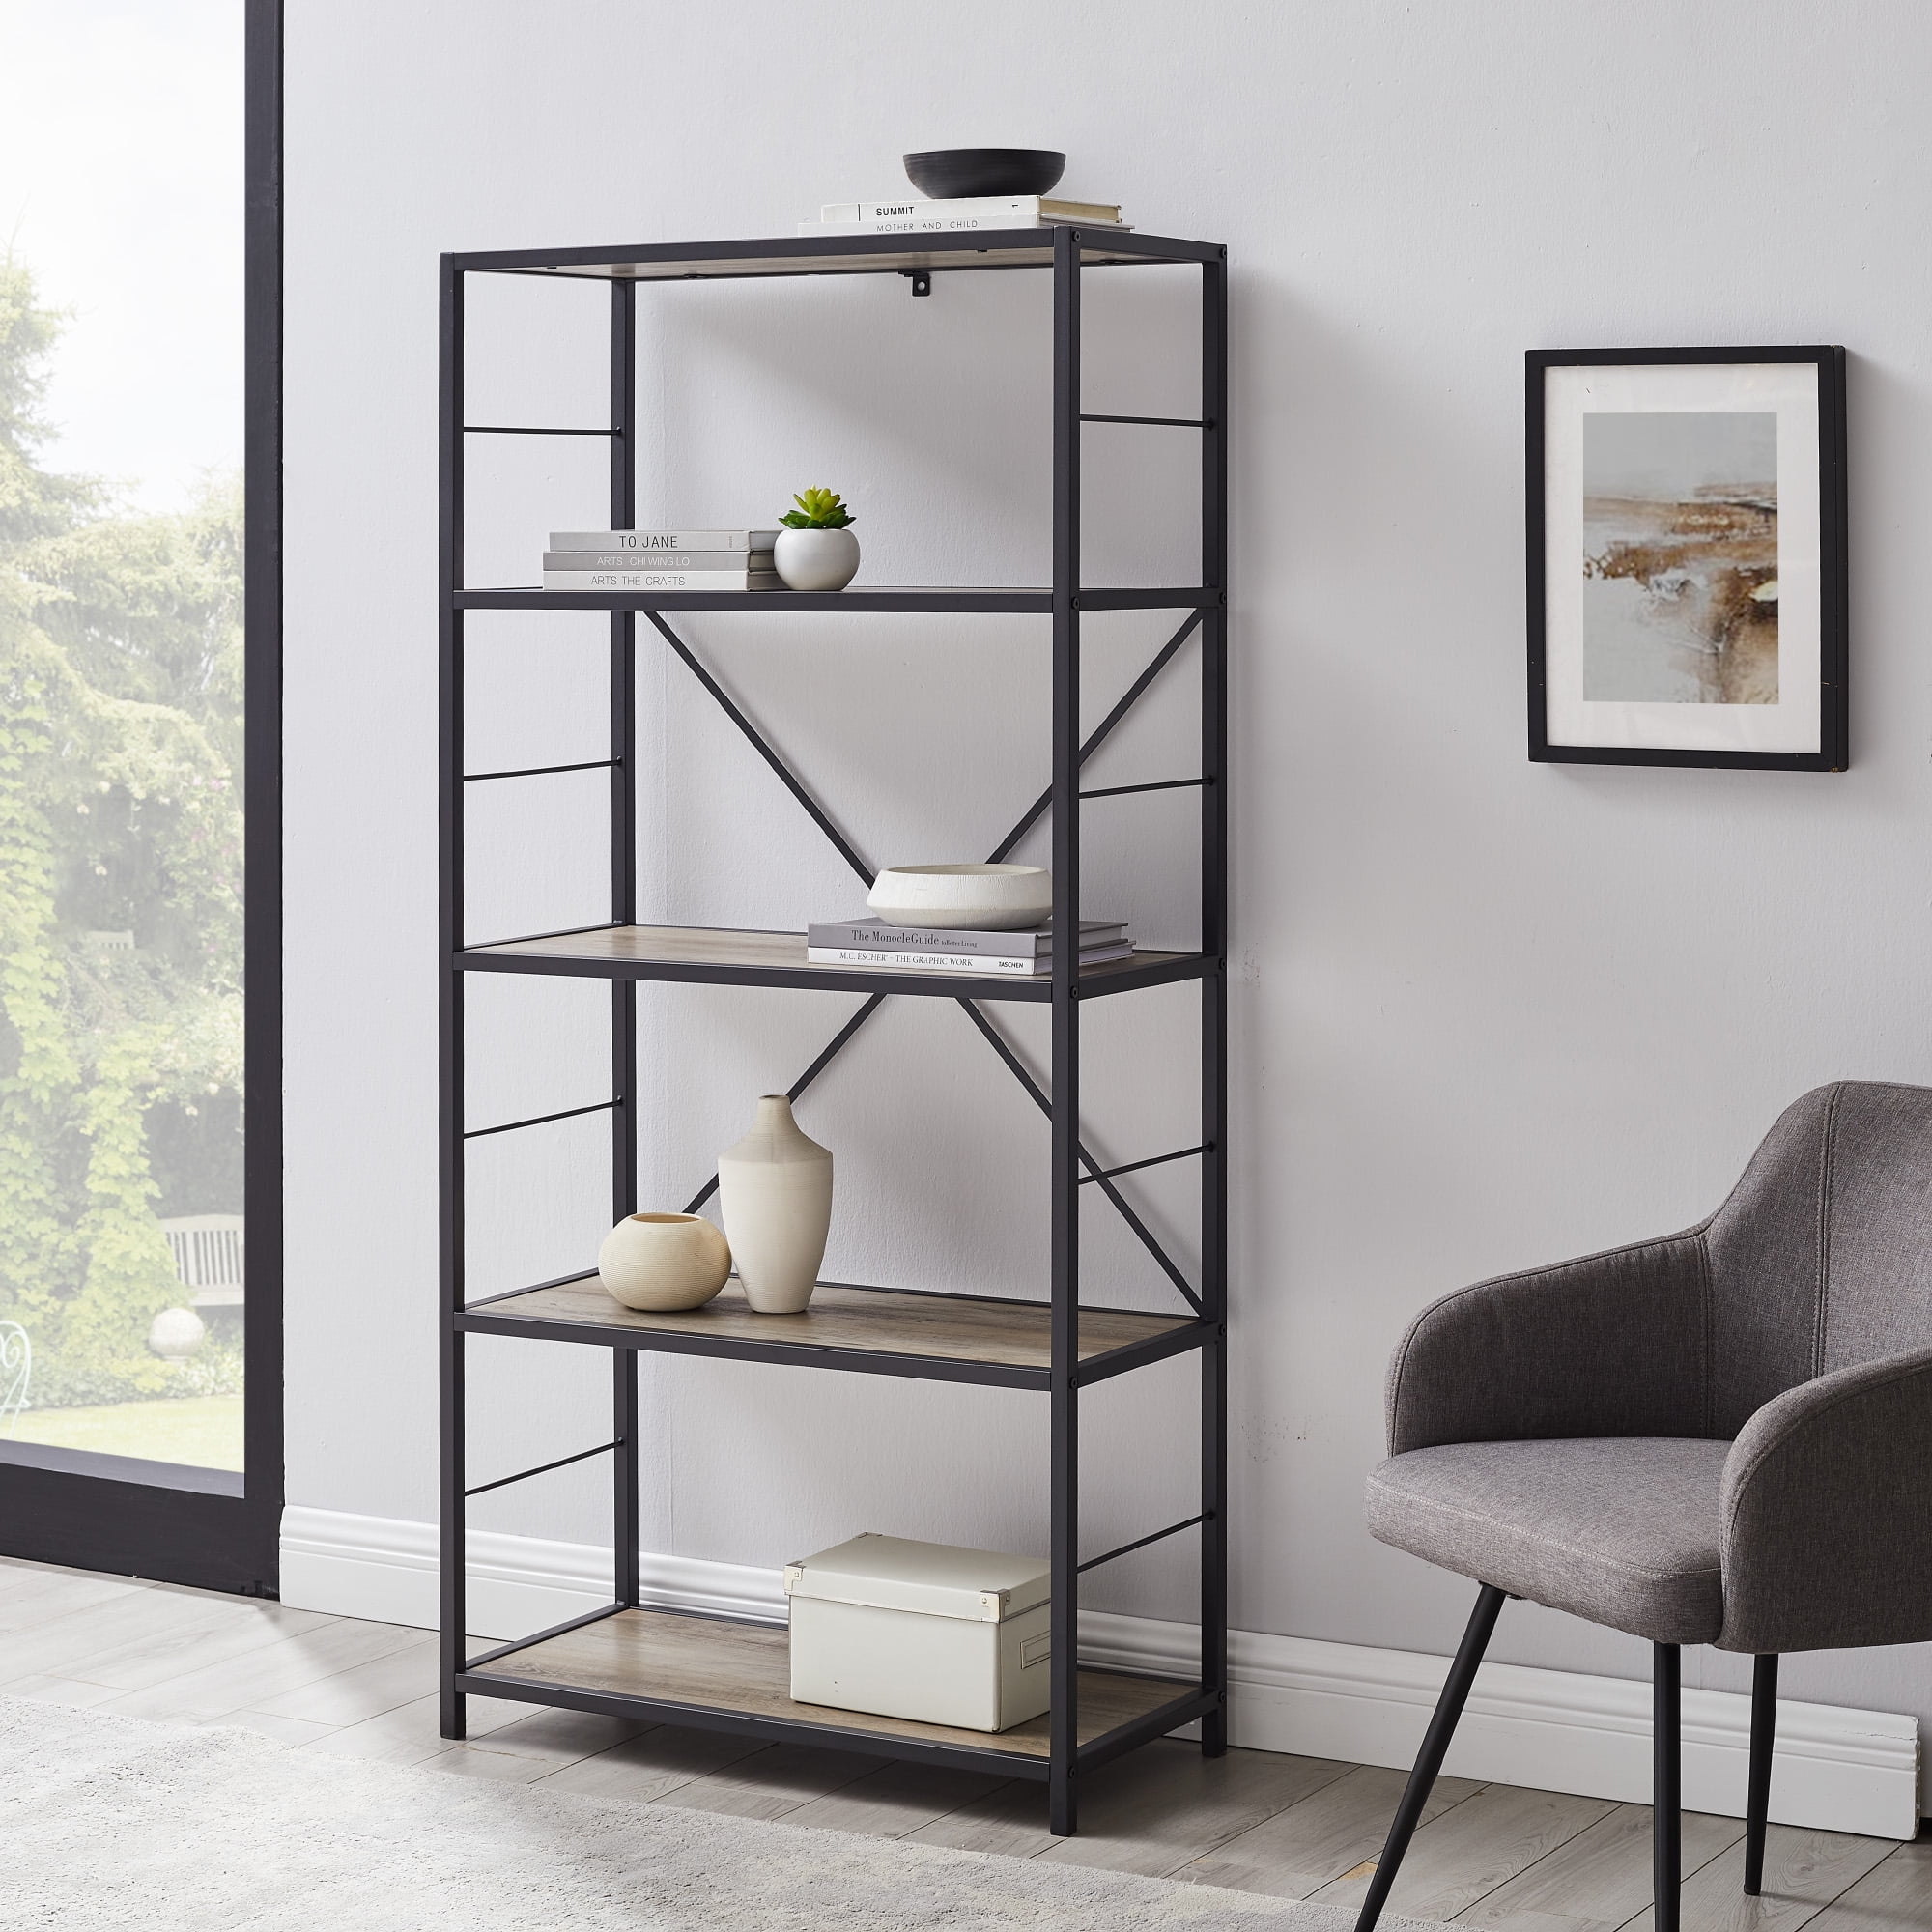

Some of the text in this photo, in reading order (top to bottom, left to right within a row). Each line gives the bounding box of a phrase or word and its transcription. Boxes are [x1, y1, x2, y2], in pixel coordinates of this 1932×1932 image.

[875, 206, 915, 217] SUMMIT
[875, 219, 979, 232] MOTHER AND CHILD
[618, 535, 678, 549] TO JANE
[596, 556, 623, 566] ARTS
[647, 556, 674, 567] WING
[675, 556, 690, 567] LO
[590, 575, 686, 586] ARTS THE CRAFTS
[851, 929, 869, 941] The
[895, 954, 911, 963] THE
[912, 955, 948, 965] GRAPHIC
[949, 957, 974, 967] WORK
